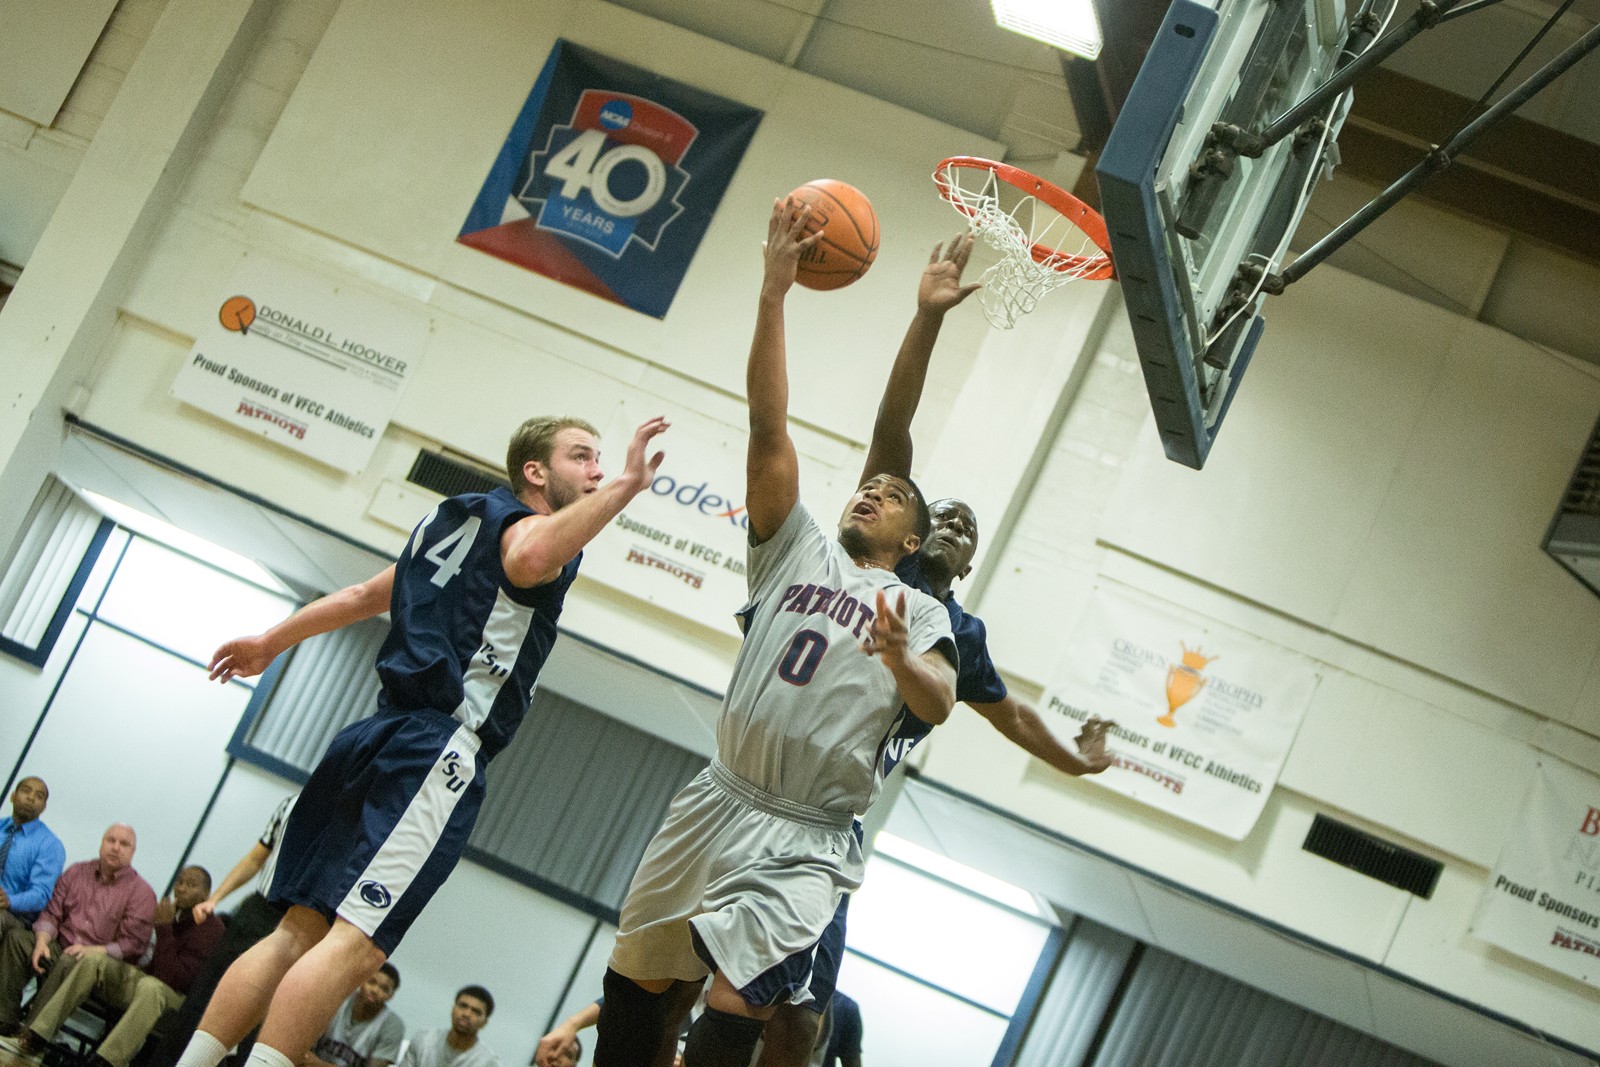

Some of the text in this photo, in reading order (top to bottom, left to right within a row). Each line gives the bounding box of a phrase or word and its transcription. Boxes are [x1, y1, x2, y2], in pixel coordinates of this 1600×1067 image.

[544, 128, 666, 217] 40
[562, 204, 615, 234] YEARS
[259, 305, 324, 338] DONALD
[341, 339, 407, 372] HOOVER
[193, 353, 228, 376] Proud
[227, 368, 280, 398] Sponsors
[281, 391, 294, 405] of
[294, 395, 324, 417] VFCC
[325, 409, 376, 439] Athletics
[236, 401, 307, 440] PATRIOTS
[651, 475, 748, 530] odex
[616, 513, 672, 545] Sponsors
[674, 538, 690, 551] of
[690, 542, 722, 565] VFCC
[723, 557, 747, 577] Ath
[626, 549, 703, 589] PATRIOTS
[480, 642, 508, 677] PSU
[778, 628, 829, 687] 0
[1113, 638, 1168, 668] CROWN
[1208, 676, 1267, 709] TROPHY
[1049, 696, 1089, 723] Proud
[1153, 741, 1168, 755] of
[1169, 744, 1204, 769] VFCC
[1204, 759, 1263, 793] Athletics
[442, 750, 466, 793] PSU
[1112, 757, 1185, 795] ATRIOTS
[1494, 873, 1600, 928] Proud Sponsors
